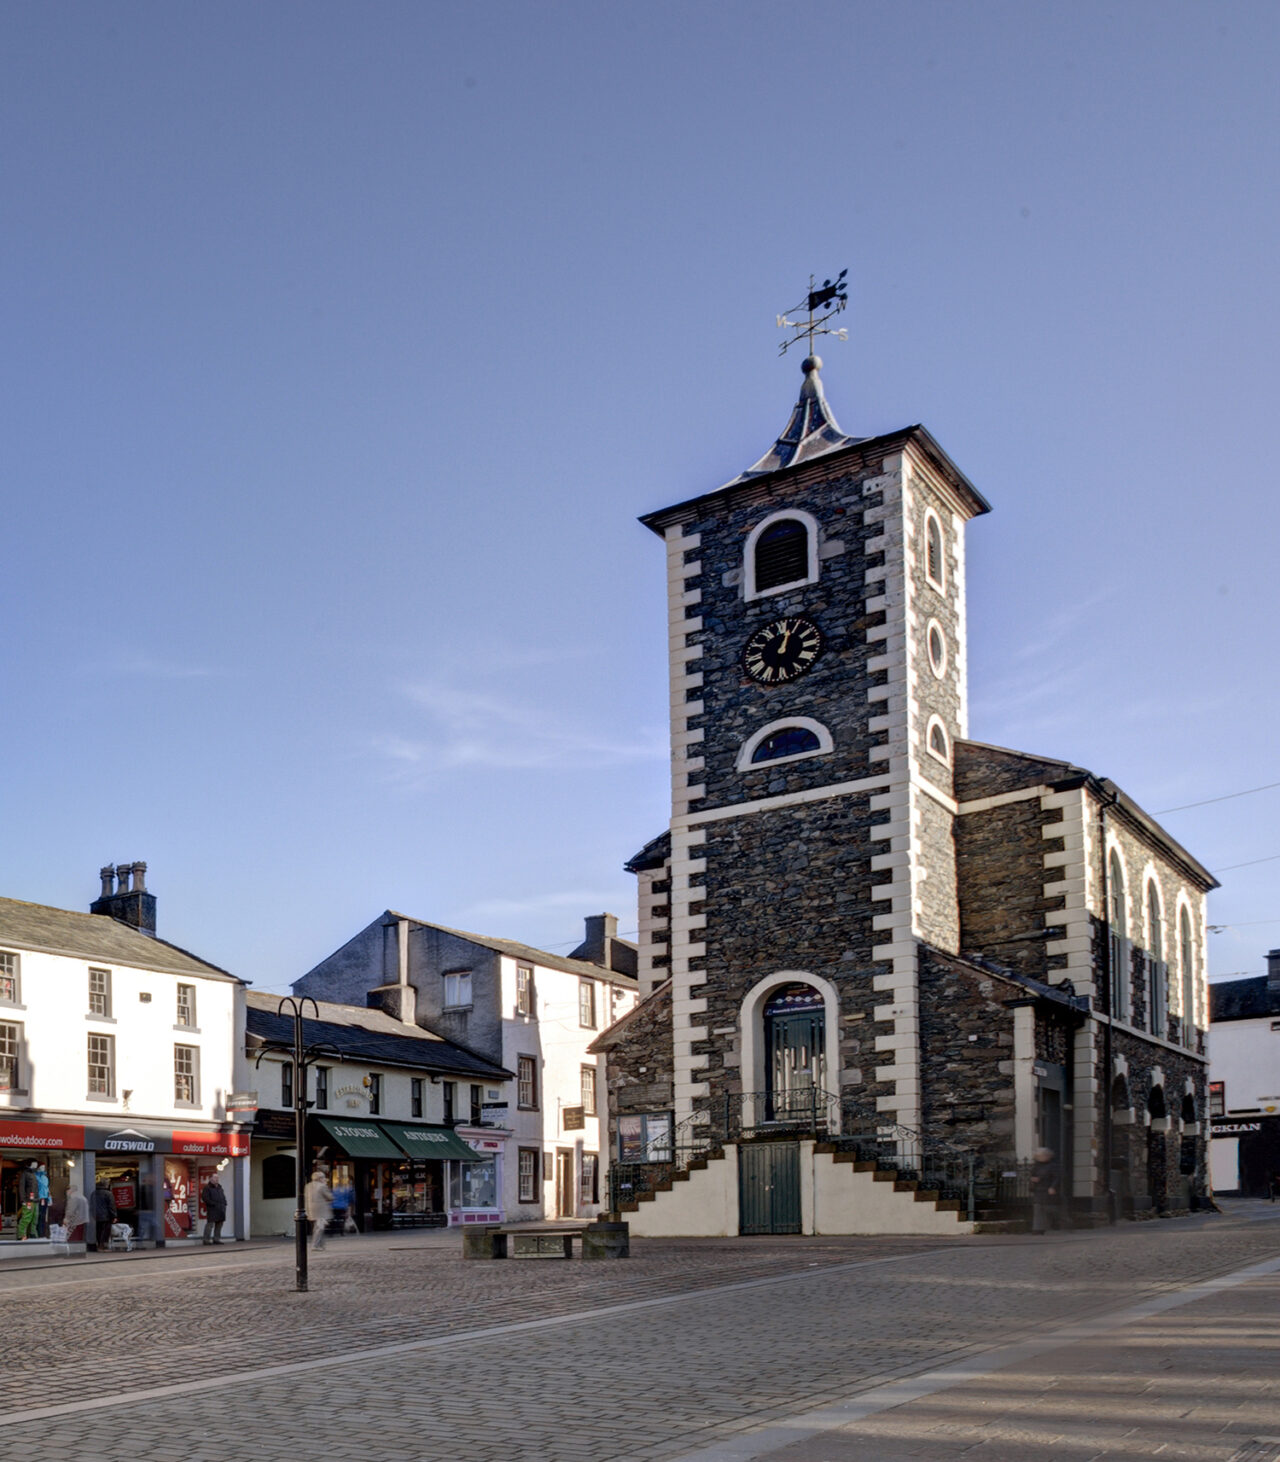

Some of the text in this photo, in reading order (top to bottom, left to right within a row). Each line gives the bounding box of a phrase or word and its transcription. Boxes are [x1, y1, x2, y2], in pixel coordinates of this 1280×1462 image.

[403, 1130, 449, 1142] ANTIQUES
[104, 1139, 155, 1151] COTSWOLD
[183, 1144, 205, 1153] outdoor
[169, 1199, 188, 1213] ale
